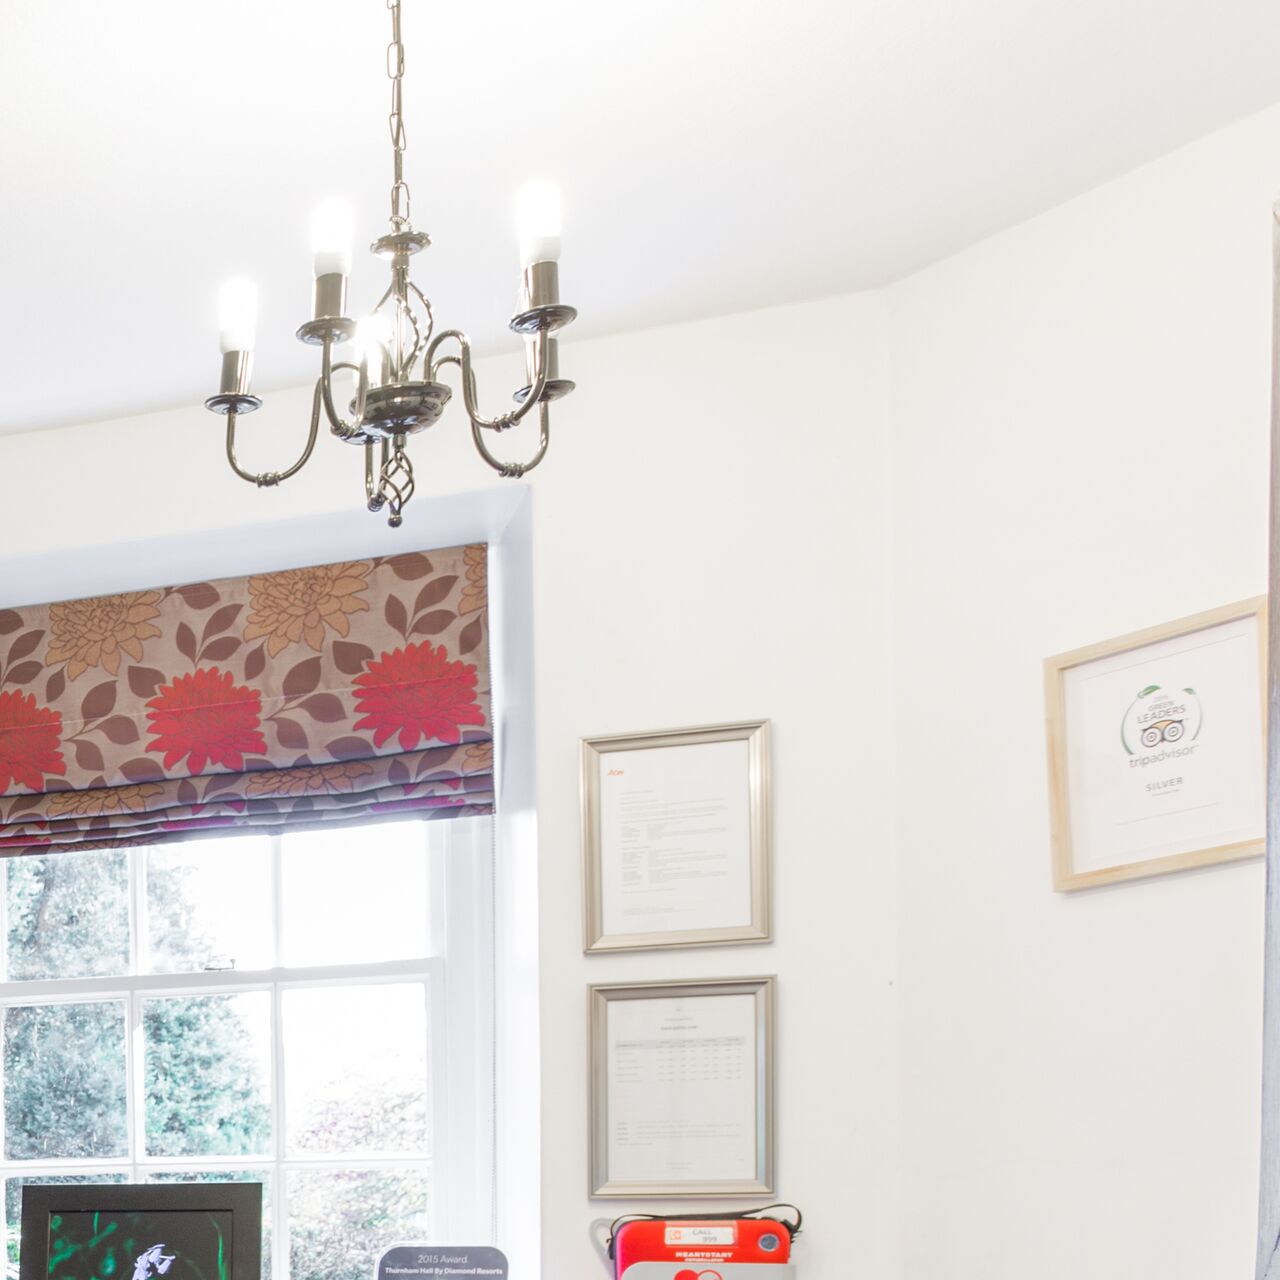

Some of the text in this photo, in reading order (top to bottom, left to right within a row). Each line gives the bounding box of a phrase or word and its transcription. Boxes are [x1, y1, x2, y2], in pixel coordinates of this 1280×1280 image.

[1137, 704, 1186, 724] LEADERS
[1129, 746, 1195, 768] tripadvisor
[1145, 776, 1184, 792] SILVER
[418, 1255, 468, 1264] 2015 Award
[434, 1268, 444, 1276] By
